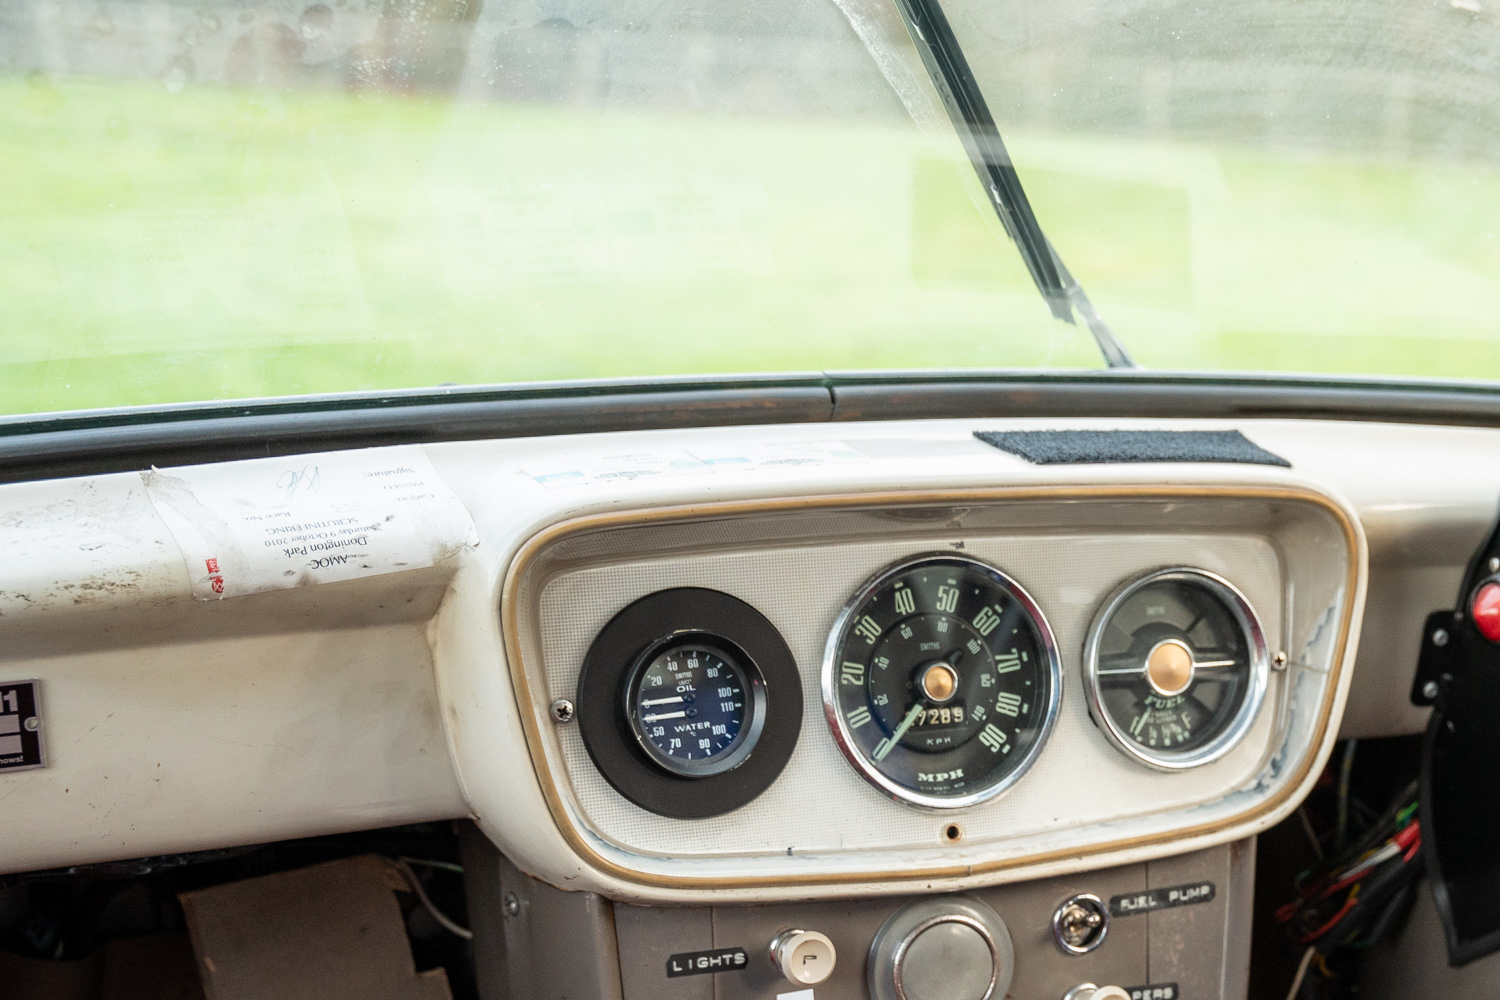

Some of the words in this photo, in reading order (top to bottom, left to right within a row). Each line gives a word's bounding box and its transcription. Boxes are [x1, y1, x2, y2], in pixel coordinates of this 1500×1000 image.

[363, 466, 415, 478] Signature:
[265, 517, 359, 535] SCRUTINEERING
[264, 538, 288, 547] 2010
[291, 532, 328, 543] October
[310, 536, 368, 554] Donington
[283, 546, 308, 559] Park
[309, 555, 348, 569] AMOC
[894, 588, 916, 616] 40
[936, 585, 960, 613] 50
[937, 621, 949, 633] 80
[972, 606, 1001, 637] 60
[854, 615, 882, 645] 30
[901, 628, 913, 640] 60
[920, 642, 940, 651] SMITHS
[967, 639, 981, 655] 100
[667, 660, 678, 672] 40
[687, 658, 699, 669] 60
[877, 656, 890, 671] 40
[995, 648, 1022, 674] 70
[707, 668, 719, 678] 80
[841, 661, 865, 686] 20
[651, 676, 662, 686] 20
[980, 673, 991, 688] 120
[676, 685, 696, 693] OIL
[718, 687, 732, 698] 100
[0, 690, 18, 714] 1
[878, 693, 889, 706] 20
[996, 691, 1022, 718] 80
[720, 701, 734, 712] 110
[847, 705, 872, 729] 10
[653, 726, 665, 737] 50
[674, 721, 711, 734] WATER
[712, 724, 727, 736] 100
[670, 738, 682, 749] 70
[699, 738, 711, 750] 90
[926, 736, 951, 745] KPH
[979, 722, 1007, 753] 90
[917, 768, 965, 782] MPH
[1120, 895, 1157, 911] FUEL
[1169, 885, 1211, 902] PUMP
[672, 952, 746, 972] LIGHTS
